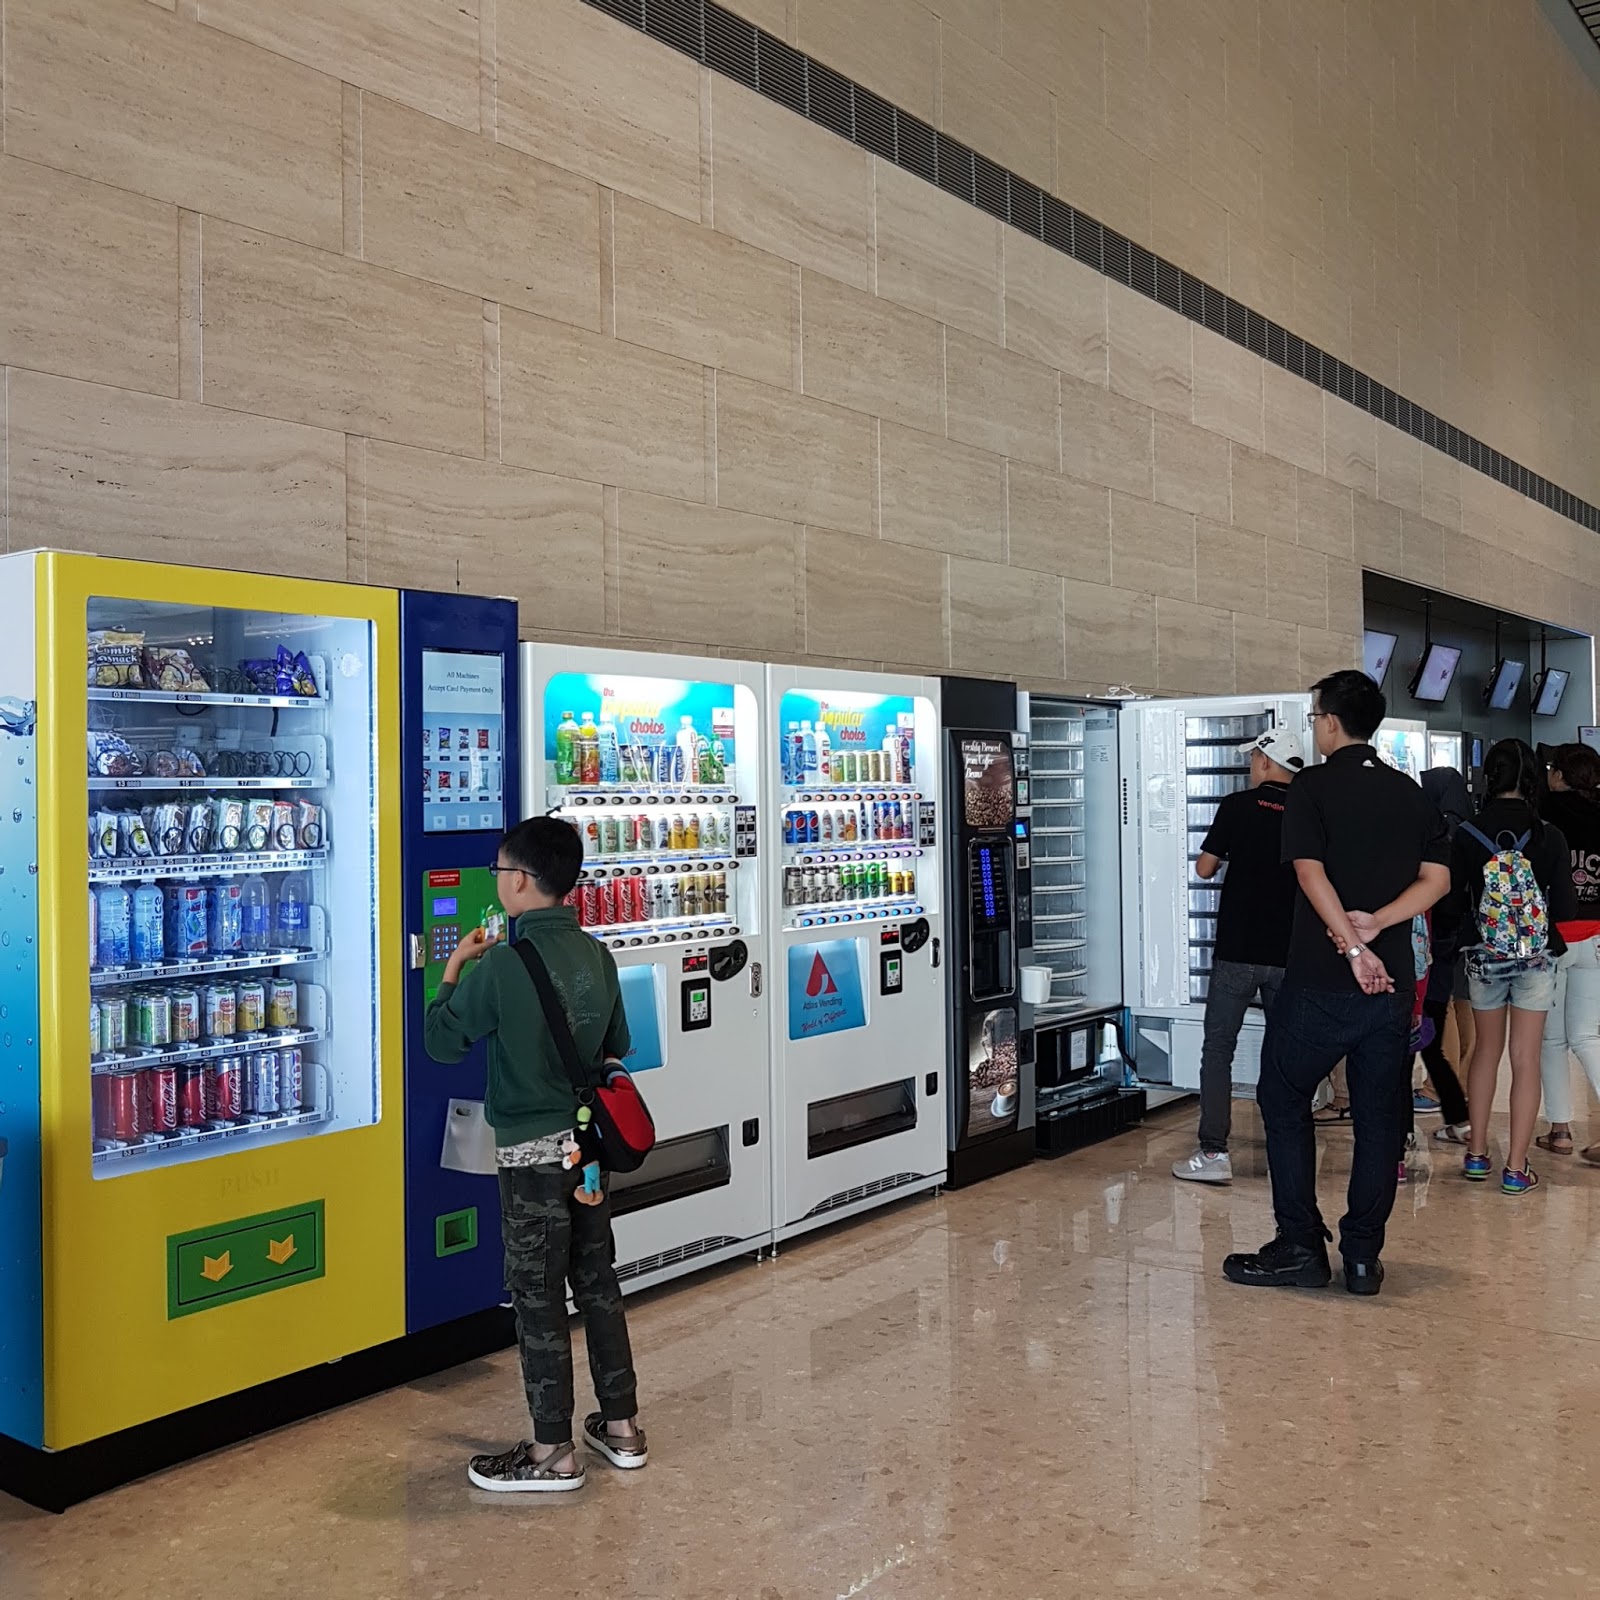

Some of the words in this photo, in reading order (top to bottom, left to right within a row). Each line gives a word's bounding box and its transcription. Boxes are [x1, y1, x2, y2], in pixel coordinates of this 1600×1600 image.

[459, 672, 480, 680] Machines
[428, 684, 445, 692] Accept
[459, 685, 481, 694] Payment
[482, 686, 494, 695] Only
[603, 687, 615, 697] the
[820, 701, 829, 709] the
[820, 708, 865, 731] popular
[630, 717, 666, 735] choice
[840, 727, 867, 741] choice
[1257, 799, 1285, 811] Vendin
[803, 1000, 818, 1011] Atlas
[819, 997, 843, 1008] Vending
[801, 1019, 818, 1032] World
